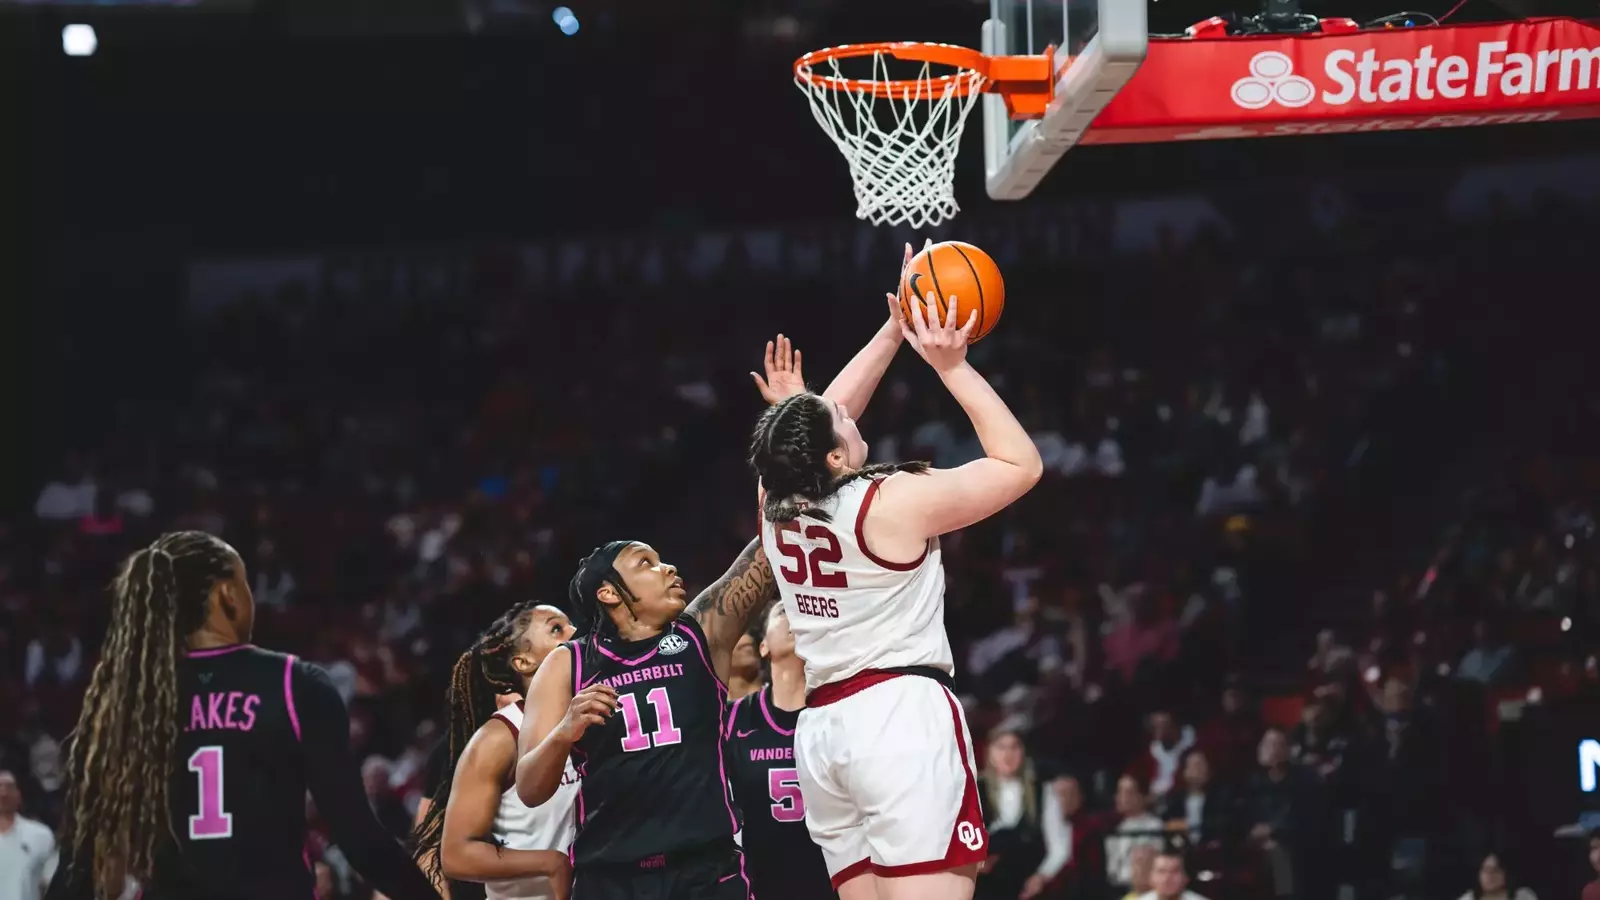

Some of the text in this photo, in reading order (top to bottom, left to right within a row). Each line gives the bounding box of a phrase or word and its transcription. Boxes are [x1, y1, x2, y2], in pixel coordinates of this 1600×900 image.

[774, 519, 848, 588] 52
[795, 594, 839, 618] BEERS
[659, 635, 683, 651] SEC
[598, 664, 684, 688] ANDERBILT
[184, 691, 261, 732] AKES
[615, 687, 681, 752] 11
[750, 747, 797, 761] VANDE
[188, 745, 232, 840] 1
[768, 767, 805, 822] 5
[957, 821, 984, 851] OU
